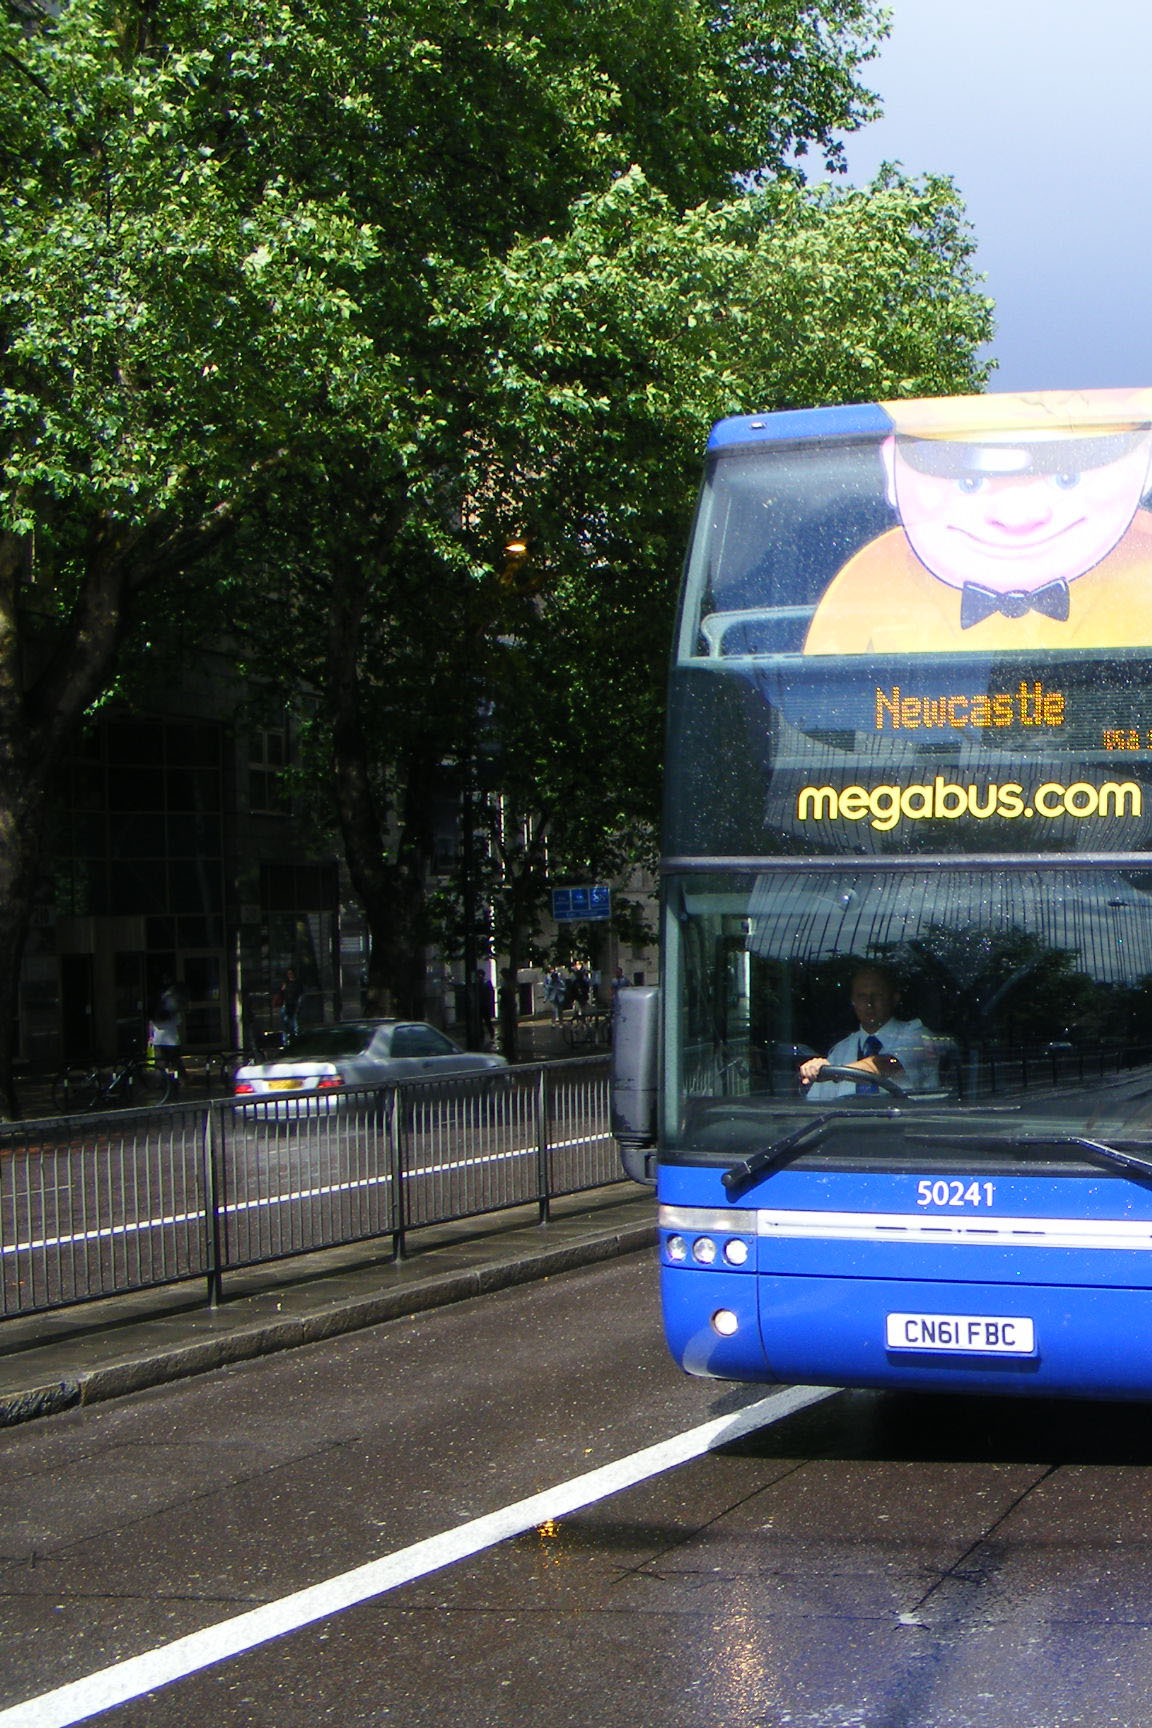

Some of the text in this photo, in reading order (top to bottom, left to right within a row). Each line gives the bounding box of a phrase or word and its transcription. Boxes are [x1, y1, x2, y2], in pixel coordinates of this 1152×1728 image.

[874, 681, 1066, 729] Newcastle
[797, 776, 1142, 831] megabus.com
[916, 1180, 994, 1207] 50241
[904, 1317, 1016, 1347] CN61 FBC
